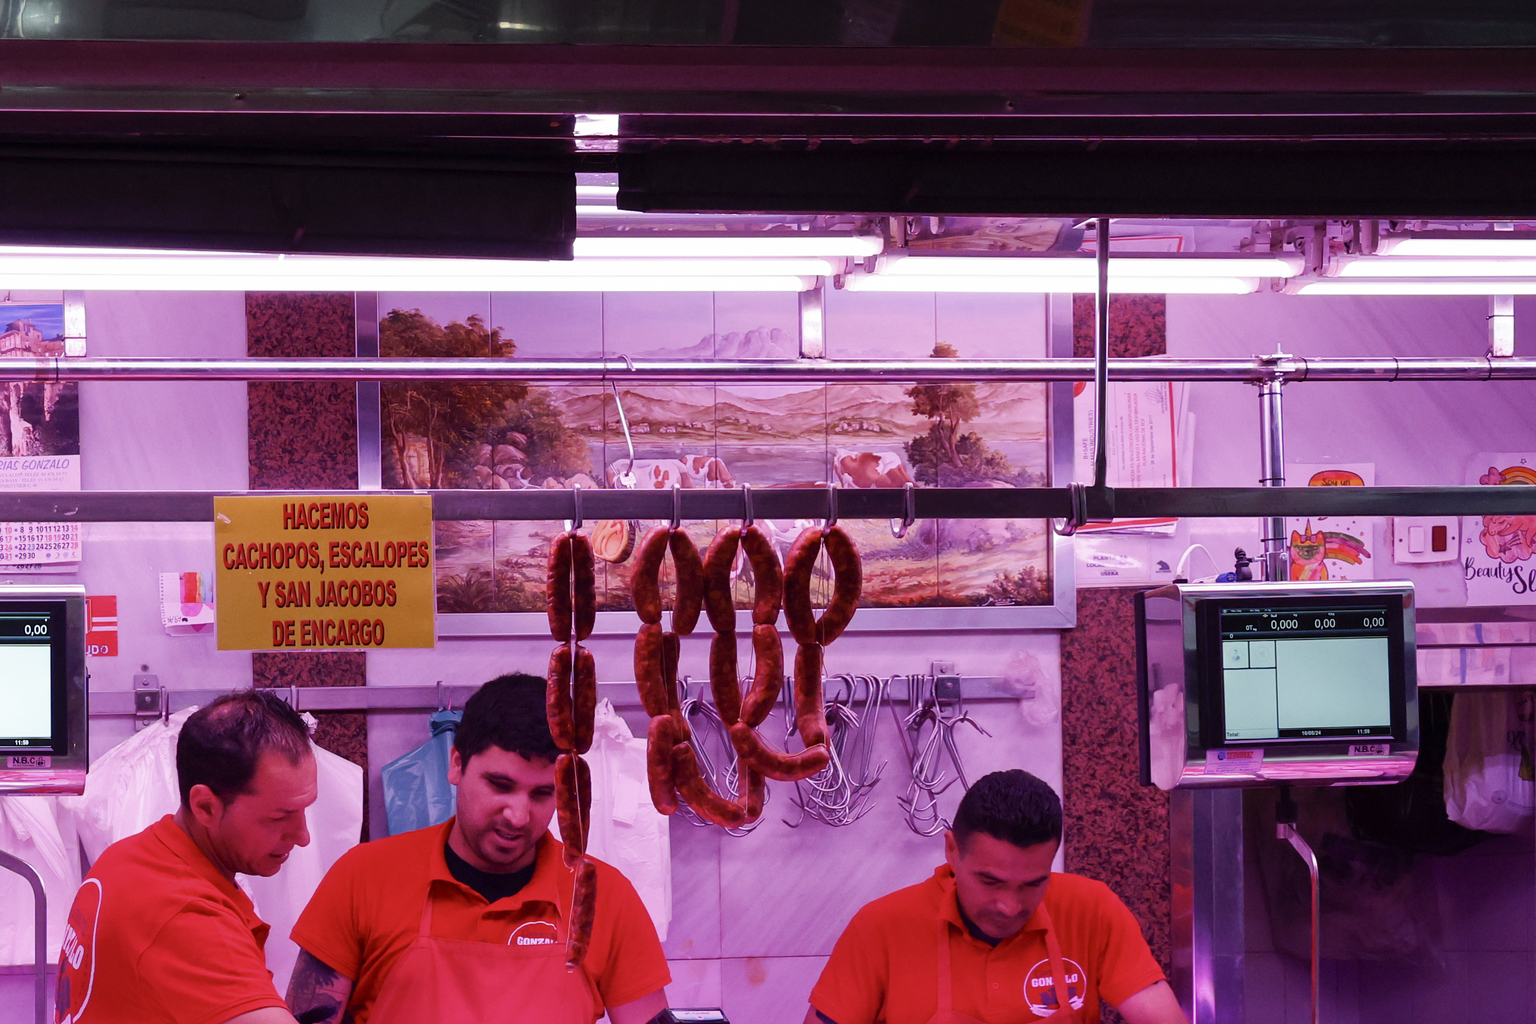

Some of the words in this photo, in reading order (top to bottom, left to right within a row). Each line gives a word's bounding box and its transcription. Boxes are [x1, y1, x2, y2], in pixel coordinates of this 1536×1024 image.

[22, 459, 70, 470] GONZALO
[283, 502, 369, 529] HACEMOS
[223, 542, 324, 574] CACHOPOS,
[329, 541, 429, 568] ESCALOPES
[1464, 557, 1513, 582] Beauty
[1513, 564, 1536, 594] Sl
[258, 581, 270, 608] Y
[275, 581, 310, 608] SAN
[316, 580, 397, 607] JACOBOS
[24, 625, 48, 636] 0,00
[272, 620, 296, 646] DE
[301, 619, 384, 646] ENCARGO
[1270, 620, 1298, 631] 0,000
[1314, 619, 1336, 630] 0,00
[1364, 618, 1384, 628] 0,00
[1226, 752, 1254, 760] SERVIRUIZ
[1031, 974, 1078, 988] GONLO
